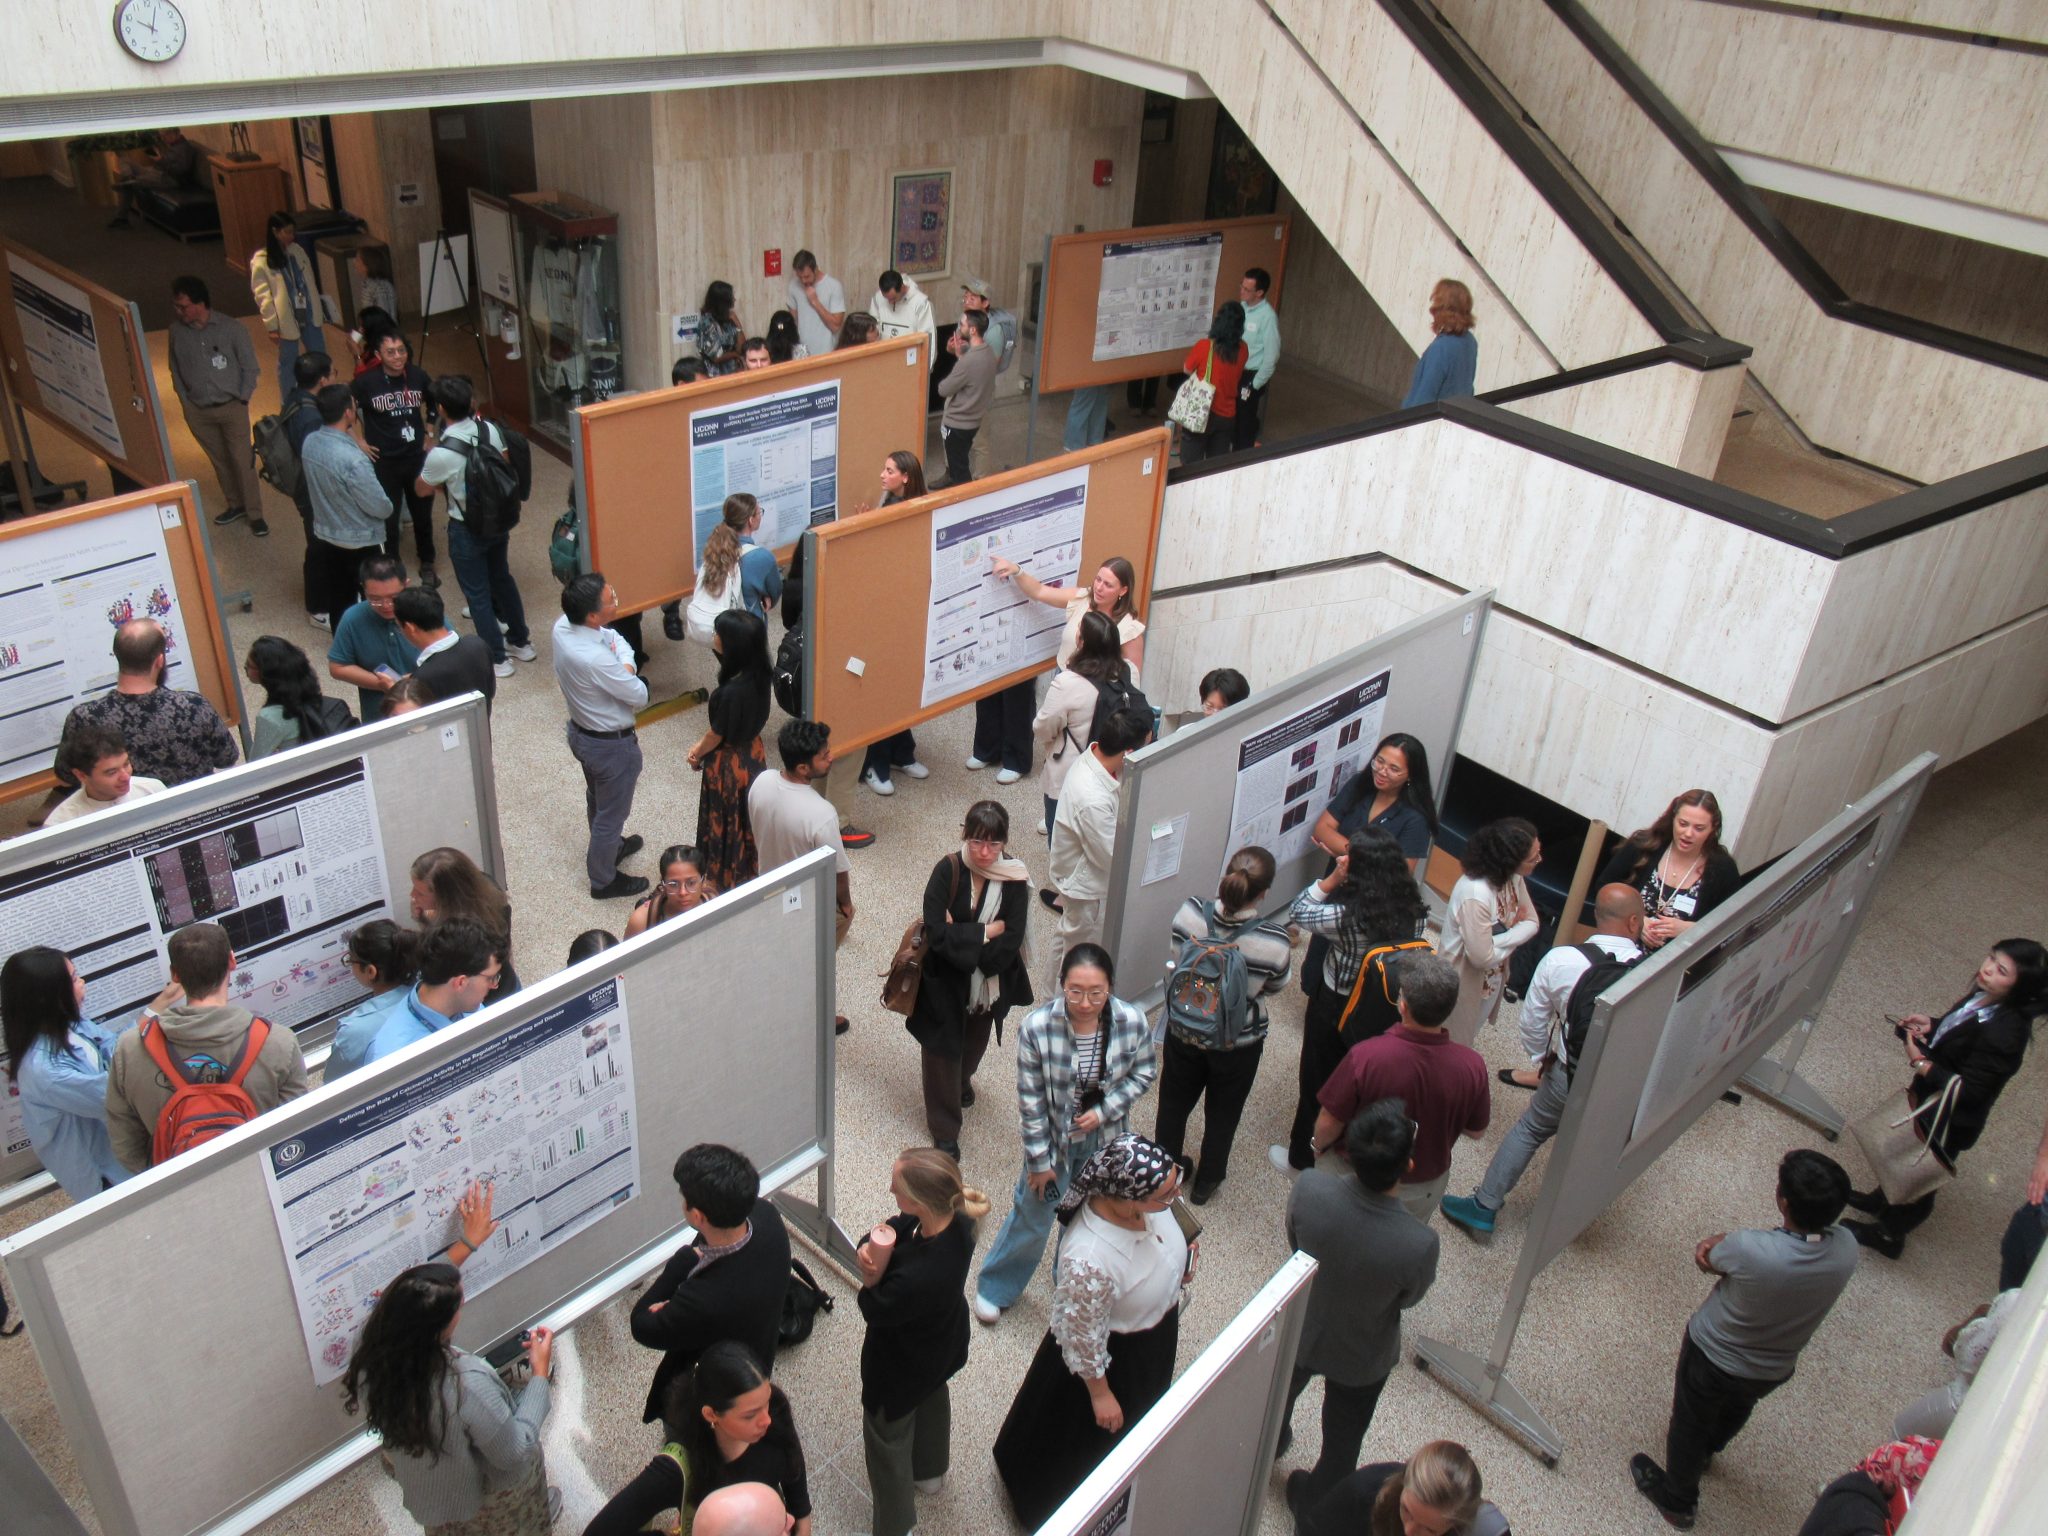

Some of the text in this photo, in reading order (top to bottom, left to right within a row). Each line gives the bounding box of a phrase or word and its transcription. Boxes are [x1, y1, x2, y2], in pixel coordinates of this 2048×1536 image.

[372, 390, 422, 412] UCONN
[815, 395, 835, 404] UCONN
[694, 422, 718, 433] UCONN
[1358, 680, 1382, 698] UCONN
[1359, 691, 1377, 702] HEALTH
[80, 845, 108, 856] Deletion
[110, 833, 143, 846] Increases
[144, 809, 216, 836] Macrophage-Mediated
[135, 842, 159, 854] Results
[588, 982, 614, 1000] UCONN
[591, 990, 611, 1003] HEALTH
[338, 1108, 365, 1125] Defining
[376, 1096, 391, 1105] Role
[399, 1075, 432, 1094] Calcineurin
[432, 1065, 454, 1078] Activity
[472, 1041, 501, 1059] Regulation
[508, 1025, 533, 1041] Signaling
[544, 1009, 564, 1021] Disease
